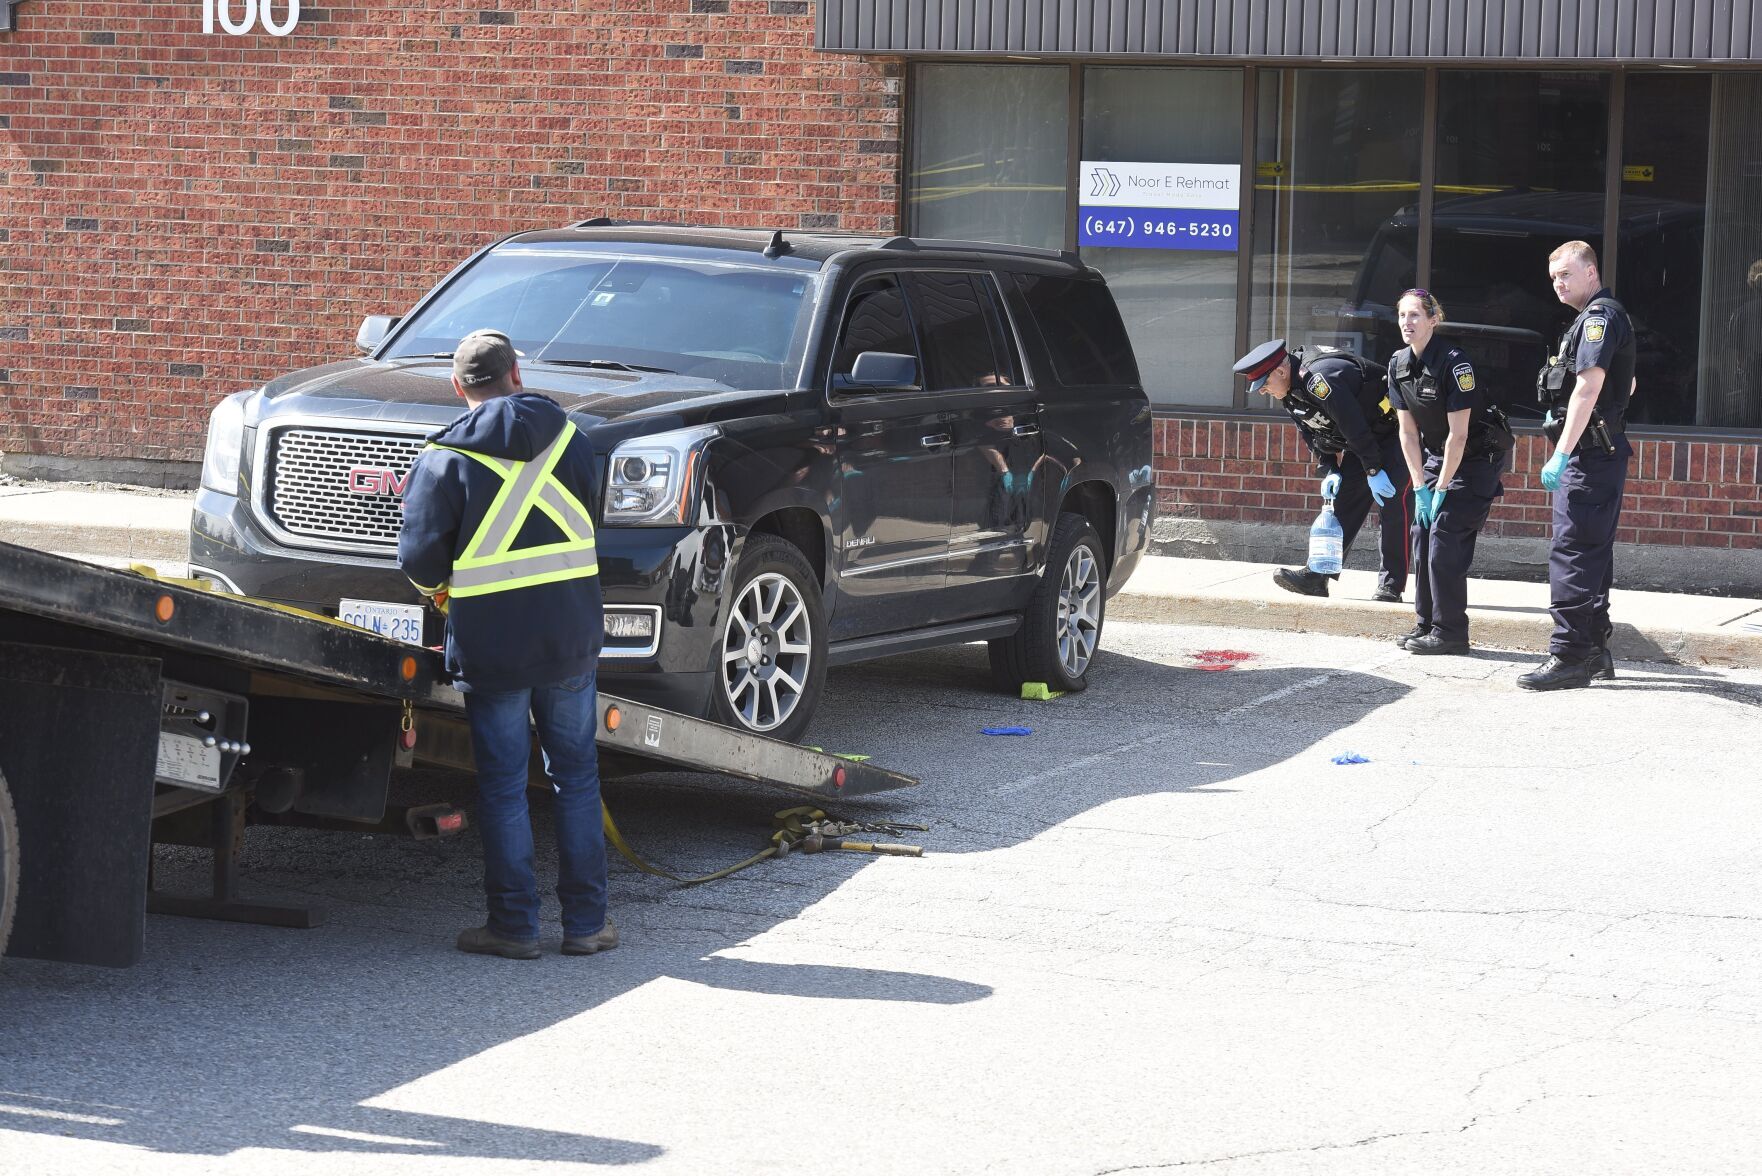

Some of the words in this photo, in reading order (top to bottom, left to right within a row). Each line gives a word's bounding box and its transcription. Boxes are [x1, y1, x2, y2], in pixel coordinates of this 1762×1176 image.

[203, 0, 300, 36] 100
[1128, 175, 1161, 188] Noor
[1165, 176, 1172, 188] E
[1177, 176, 1230, 190] Rehmat
[1085, 216, 1135, 237] (647)
[1143, 221, 1232, 237] 946-5230
[846, 536, 876, 548] DENALI
[365, 606, 398, 616] ONTARIO
[391, 618, 420, 641] 235
